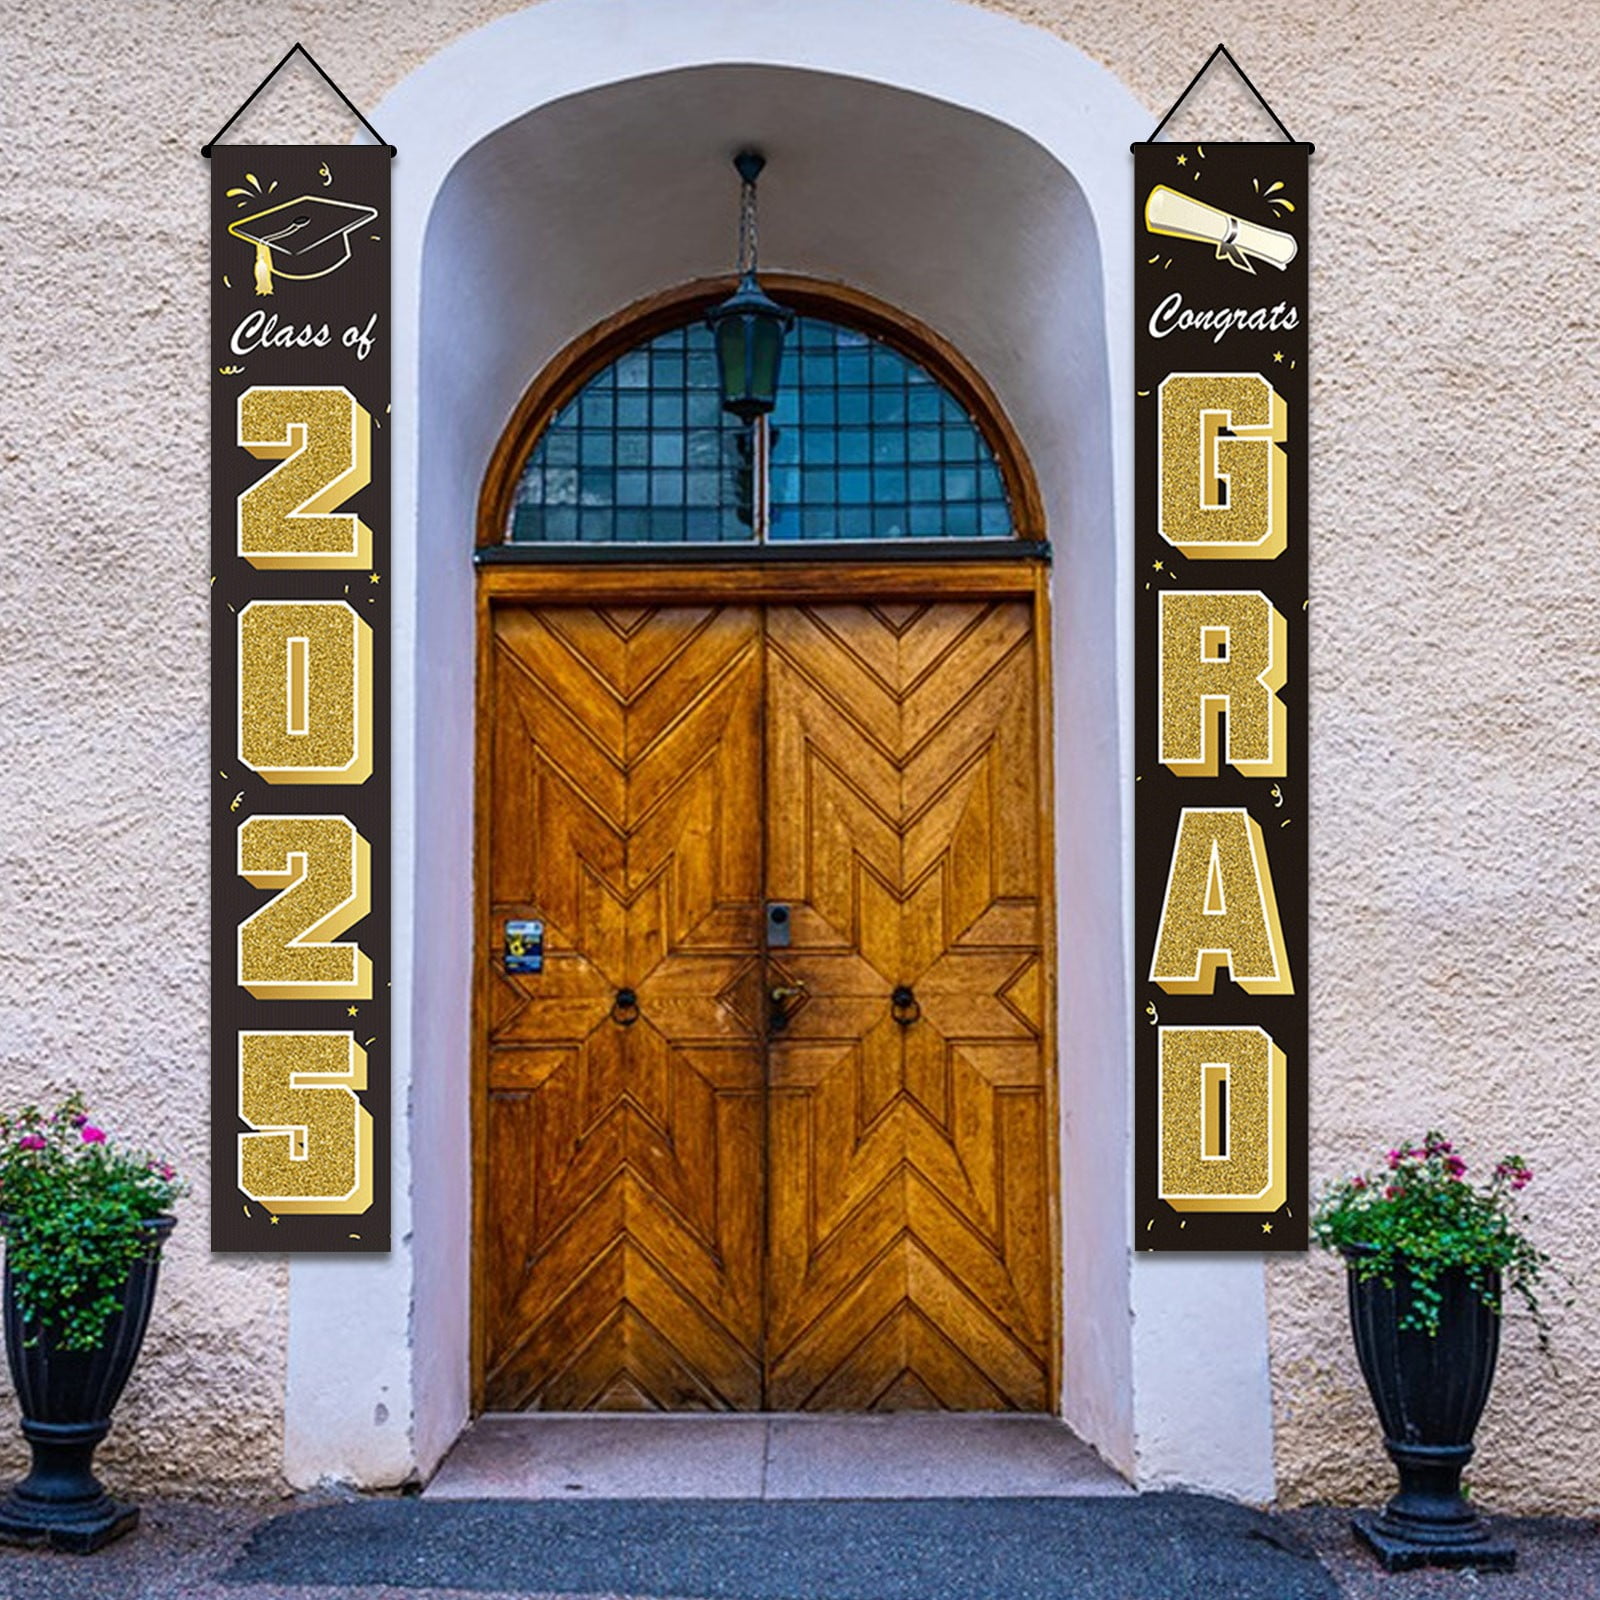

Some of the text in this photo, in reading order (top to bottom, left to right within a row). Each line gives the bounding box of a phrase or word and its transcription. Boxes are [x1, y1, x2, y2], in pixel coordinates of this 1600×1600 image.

[230, 309, 378, 361] Class of
[1148, 292, 1300, 344] Congrats
[237, 385, 374, 1215] 2025
[1148, 372, 1295, 1213] GRAD
